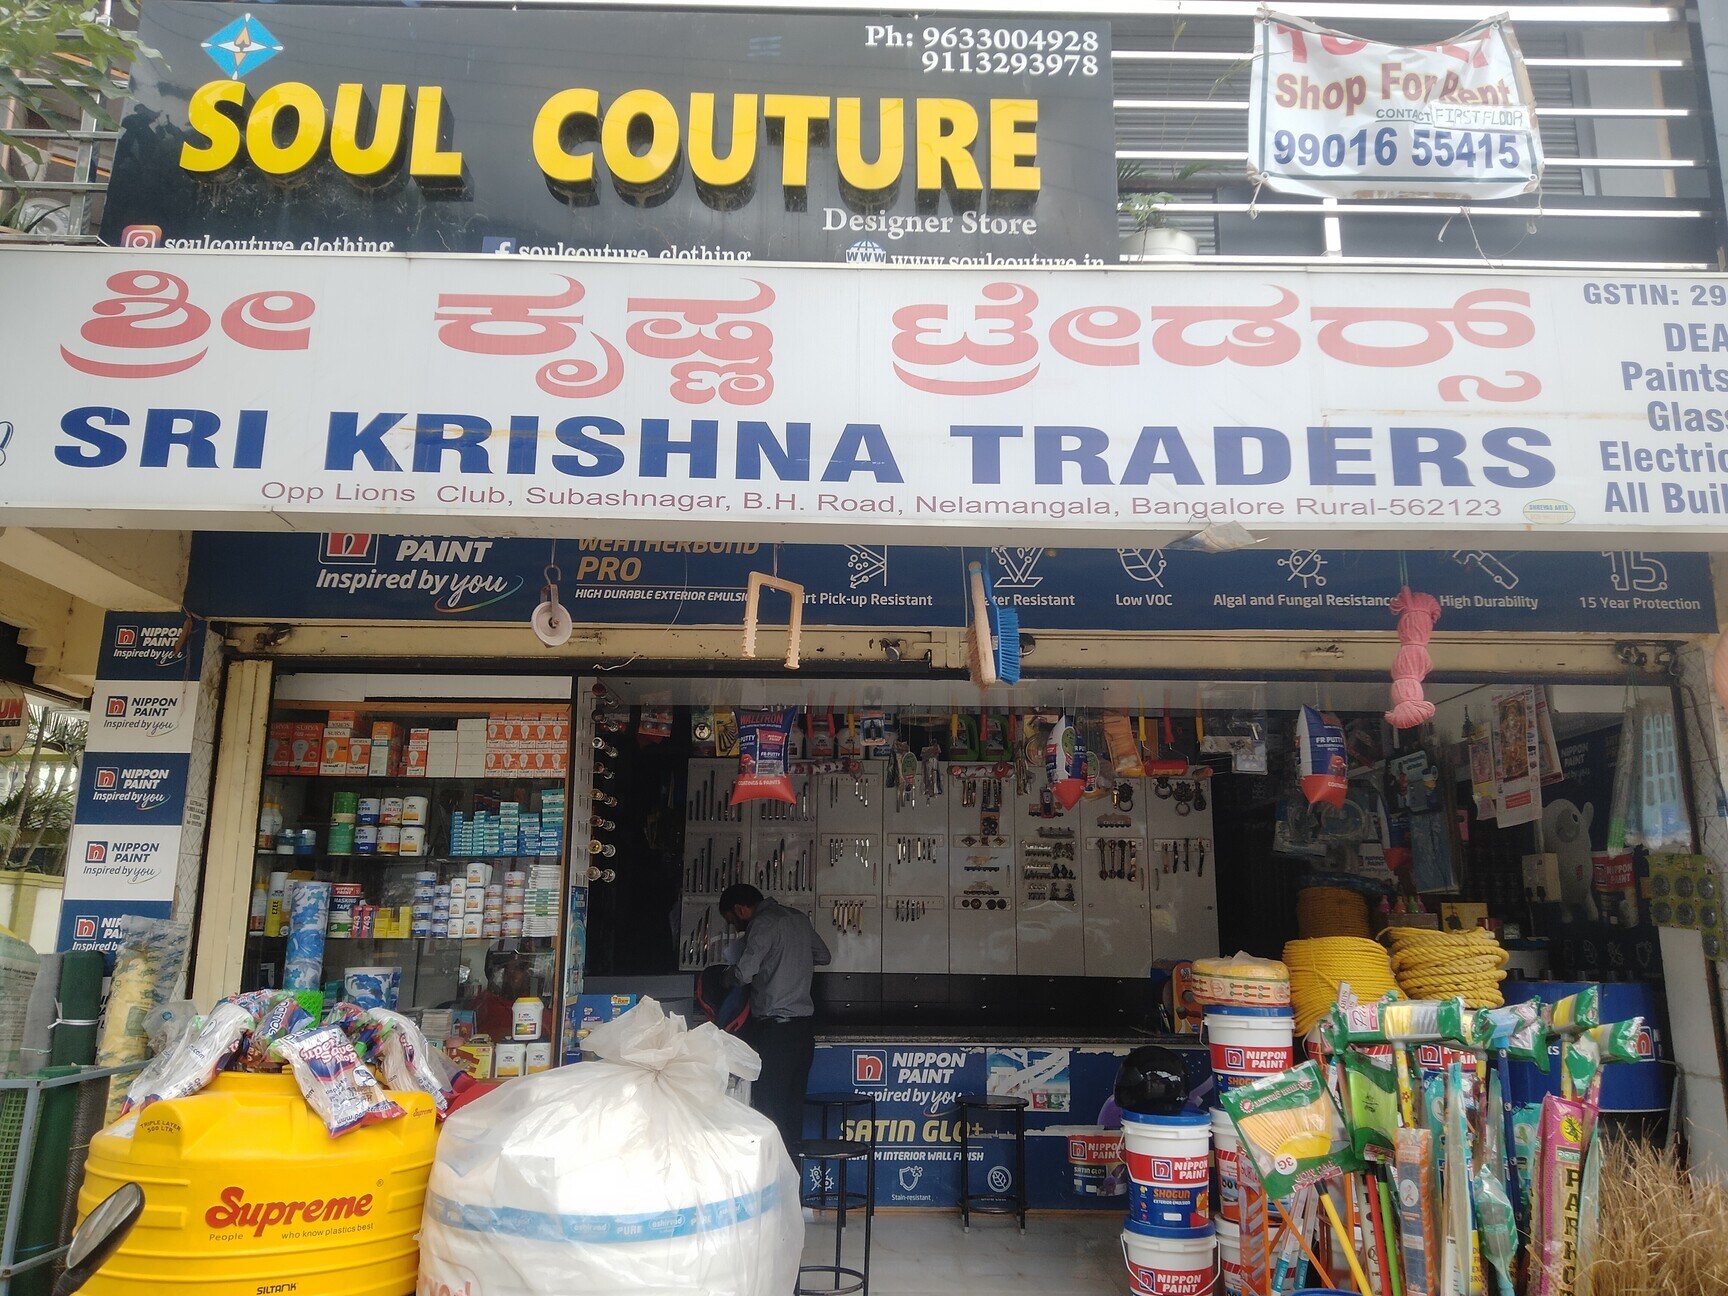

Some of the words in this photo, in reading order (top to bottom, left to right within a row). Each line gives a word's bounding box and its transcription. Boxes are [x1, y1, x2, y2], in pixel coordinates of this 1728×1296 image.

[865, 25, 913, 46] Ph:
[922, 27, 1099, 51] 9633004928
[921, 51, 1099, 75] 9113293978
[1275, 73, 1367, 117] Shop
[1381, 62, 1437, 103] For
[1438, 70, 1511, 106] Rent
[179, 80, 462, 176] SOUL
[532, 88, 1041, 190] COUTURE
[1273, 126, 1398, 168] 99016
[1412, 129, 1520, 169] 55415
[822, 208, 954, 240] Designer
[961, 210, 1037, 235] Store
[1583, 282, 1680, 306] GSTIN:
[1647, 400, 1728, 433] Glas
[54, 406, 269, 470] SRI
[324, 411, 905, 485] KRISHNA
[948, 425, 1556, 489] TRADERS
[261, 481, 324, 504] Opp
[336, 483, 416, 502] Lions
[436, 485, 513, 507] Club,
[525, 486, 731, 513] Subashnagar,
[742, 493, 805, 511] B.H.
[817, 494, 903, 516] Road,
[916, 496, 1121, 519] Nelamangala,
[1131, 497, 1285, 519] Bangalore
[1296, 498, 1502, 517] Rural-562123
[1604, 481, 1650, 514] All
[396, 540, 494, 563] PAINT
[576, 556, 642, 582] PRO
[316, 568, 418, 594] Inspired
[418, 569, 450, 595] by
[449, 573, 509, 608] you
[575, 588, 602, 599] HIGH
[603, 589, 653, 600] DURABLE
[655, 591, 706, 601] EXTERIOR
[819, 592, 867, 607] Pick-up
[871, 594, 933, 606] Resistant
[1013, 594, 1076, 607] Resistant
[1115, 594, 1143, 607] Low
[1145, 594, 1173, 607] VOC
[1213, 594, 1247, 608] Algal
[1249, 594, 1275, 607] and
[1277, 594, 1323, 610] Fungal
[1440, 595, 1472, 610] High
[1474, 595, 1539, 612] Durability
[1579, 596, 1597, 609] 15
[1599, 597, 1631, 610] Year
[1633, 597, 1701, 611] Protection
[142, 637, 178, 647] PAINT
[113, 648, 149, 660] Inspired
[149, 649, 161, 660] by
[131, 697, 178, 708] NIPPON
[133, 707, 169, 718] PAINT
[103, 719, 140, 730] Inspired
[140, 719, 152, 731] by
[151, 721, 174, 736] you
[121, 768, 169, 779] NIPPON
[123, 779, 161, 790] PAINT
[92, 791, 130, 802] Inspired
[130, 791, 143, 804] by
[142, 793, 166, 809] you
[111, 842, 160, 853] NIPPON
[113, 853, 151, 864] PAINT
[82, 865, 120, 877] Inspired
[120, 865, 133, 878] by
[132, 867, 156, 883] you
[72, 941, 111, 952] Inspired
[892, 1052, 967, 1068] NIPPON
[1246, 1050, 1287, 1061] NIPPON
[1251, 1059, 1285, 1069] PAINT
[897, 1068, 955, 1084] PAINT
[912, 1088, 931, 1106] by
[140, 1119, 161, 1129] TRIPLE
[161, 1120, 182, 1131] LAYER
[883, 1151, 926, 1161] INTERIOR
[927, 1151, 951, 1161] WALL
[1174, 1160, 1208, 1171] NIPPON
[1179, 1170, 1207, 1180] PAINT
[1153, 1188, 1191, 1199] SHOGUN
[205, 1186, 374, 1238] Supreme
[209, 1232, 244, 1242] People
[281, 1231, 301, 1240] who
[302, 1229, 324, 1238] know
[325, 1225, 356, 1238] plastics
[356, 1222, 374, 1232] best
[1157, 1273, 1202, 1284] NIPPON
[1162, 1283, 1198, 1294] PAINT
